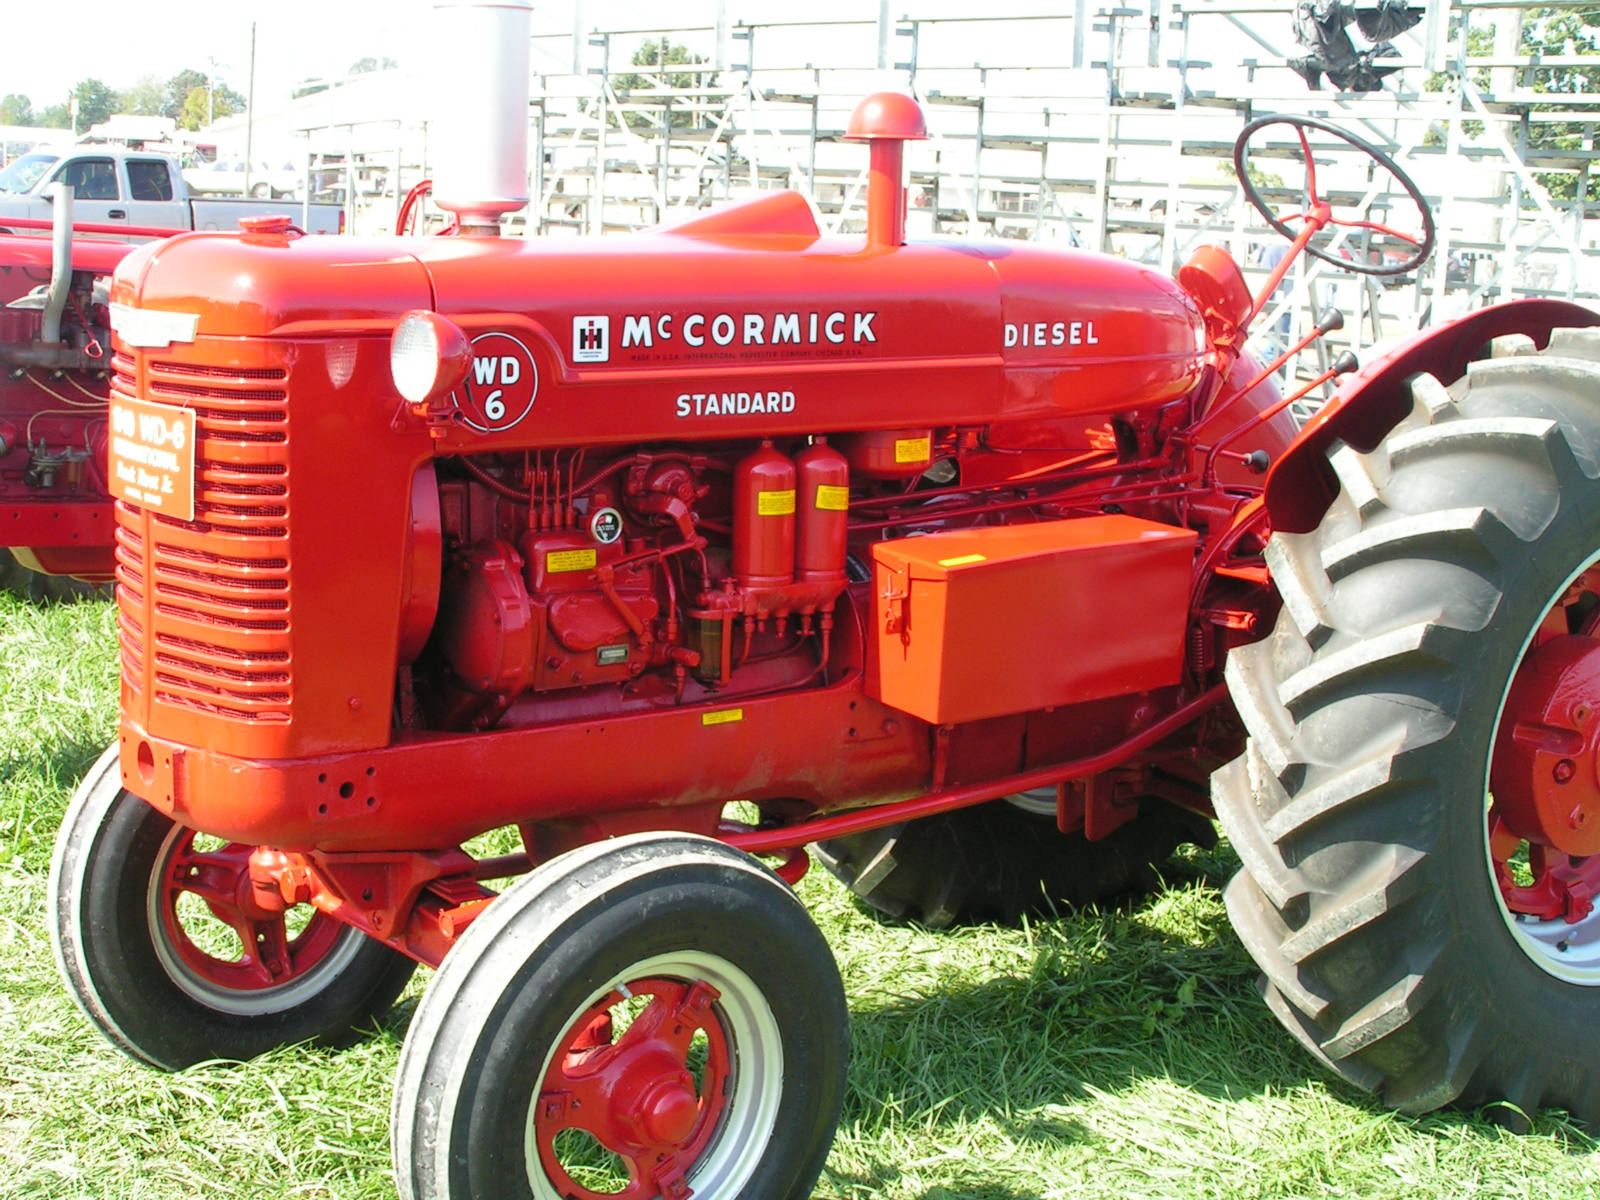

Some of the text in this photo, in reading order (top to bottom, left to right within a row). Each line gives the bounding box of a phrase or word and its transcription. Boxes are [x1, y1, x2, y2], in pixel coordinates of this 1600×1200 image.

[1003, 321, 1099, 347] DIESEL
[472, 355, 521, 386] WD
[484, 389, 506, 420] 6
[675, 390, 796, 418] STANDARD
